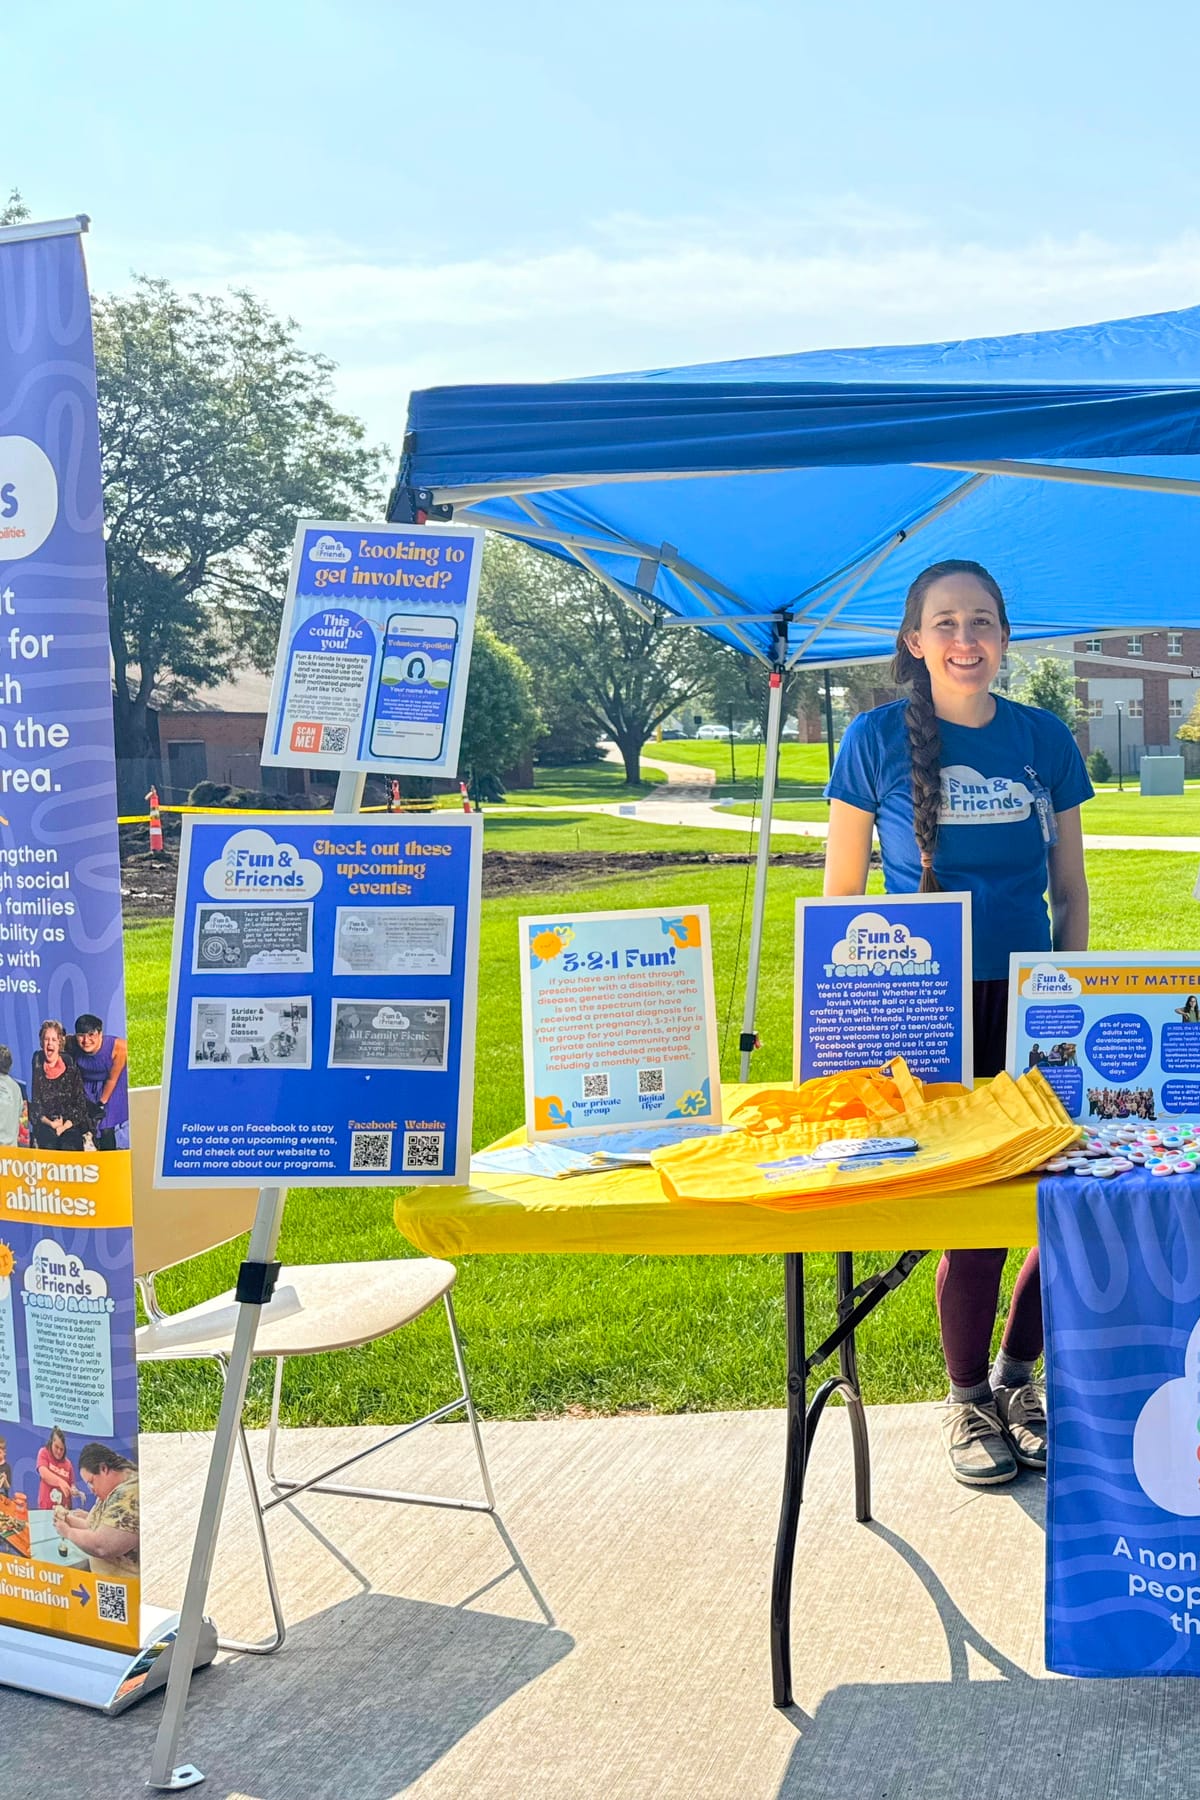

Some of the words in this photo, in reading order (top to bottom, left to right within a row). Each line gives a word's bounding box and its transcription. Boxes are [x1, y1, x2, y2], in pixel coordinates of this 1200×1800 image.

[319, 550, 346, 559] Friends
[358, 539, 440, 566] Looking
[445, 546, 465, 563] to
[314, 567, 347, 587] get
[351, 566, 452, 589] involved?
[322, 613, 350, 627] This
[309, 625, 344, 637] could
[347, 627, 363, 639] be
[8, 627, 54, 660] for
[320, 638, 349, 651] you!
[13, 717, 70, 748] the
[296, 726, 317, 736] SCAN
[294, 736, 315, 749] ME!
[949, 778, 988, 794] Fun
[993, 779, 1009, 793] &
[950, 793, 1023, 811] Friends
[313, 839, 367, 856] Check
[371, 842, 400, 856] out
[405, 840, 453, 857] these
[236, 849, 275, 868] Fun
[278, 851, 293, 868] &
[336, 860, 426, 880] upcoming
[16, 871, 70, 889] social
[235, 870, 304, 887] Friends
[348, 881, 412, 895] events:
[6, 897, 75, 916] families
[42, 927, 65, 942] as
[857, 929, 890, 944] Fun
[894, 929, 906, 944] &
[7, 949, 41, 968] with
[625, 946, 676, 968] Fun!
[857, 945, 917, 960] Friends
[823, 963, 869, 978] Teen
[872, 962, 886, 976] &
[889, 960, 940, 976] Adult
[832, 982, 853, 990] LOVE
[854, 981, 890, 990] planning
[1037, 973, 1056, 983] Fun
[1057, 974, 1066, 983] &
[1085, 975, 1120, 986] WHY
[1125, 975, 1139, 986] IT
[1036, 982, 1073, 992] Friends
[572, 1100, 588, 1108] Our
[590, 1098, 621, 1108] private
[638, 1094, 665, 1103] Digital
[583, 1107, 610, 1117] group
[182, 1123, 215, 1132] Follow
[246, 1123, 296, 1132] Facebook
[298, 1124, 309, 1132] to
[311, 1124, 334, 1134] stay
[348, 1120, 397, 1129] Facebook
[404, 1120, 446, 1129] Website
[192, 1136, 203, 1144] to
[205, 1136, 229, 1144] date
[247, 1136, 298, 1145] upcoming
[300, 1136, 338, 1145] events,
[182, 1148, 203, 1156] and
[204, 1148, 235, 1156] check
[277, 1148, 317, 1156] website
[0, 1158, 100, 1186] rograms
[174, 1160, 200, 1168] learn
[231, 1160, 262, 1168] about
[284, 1160, 336, 1170] programs.
[41, 1257, 67, 1277] Fun
[69, 1261, 81, 1278] &
[42, 1275, 93, 1296] Friends
[20, 1289, 54, 1311] Teen
[54, 1294, 66, 1312] &
[67, 1294, 116, 1315] Adult
[1111, 1536, 1133, 1560] A
[6, 1558, 35, 1580] visit
[39, 1569, 64, 1586] our
